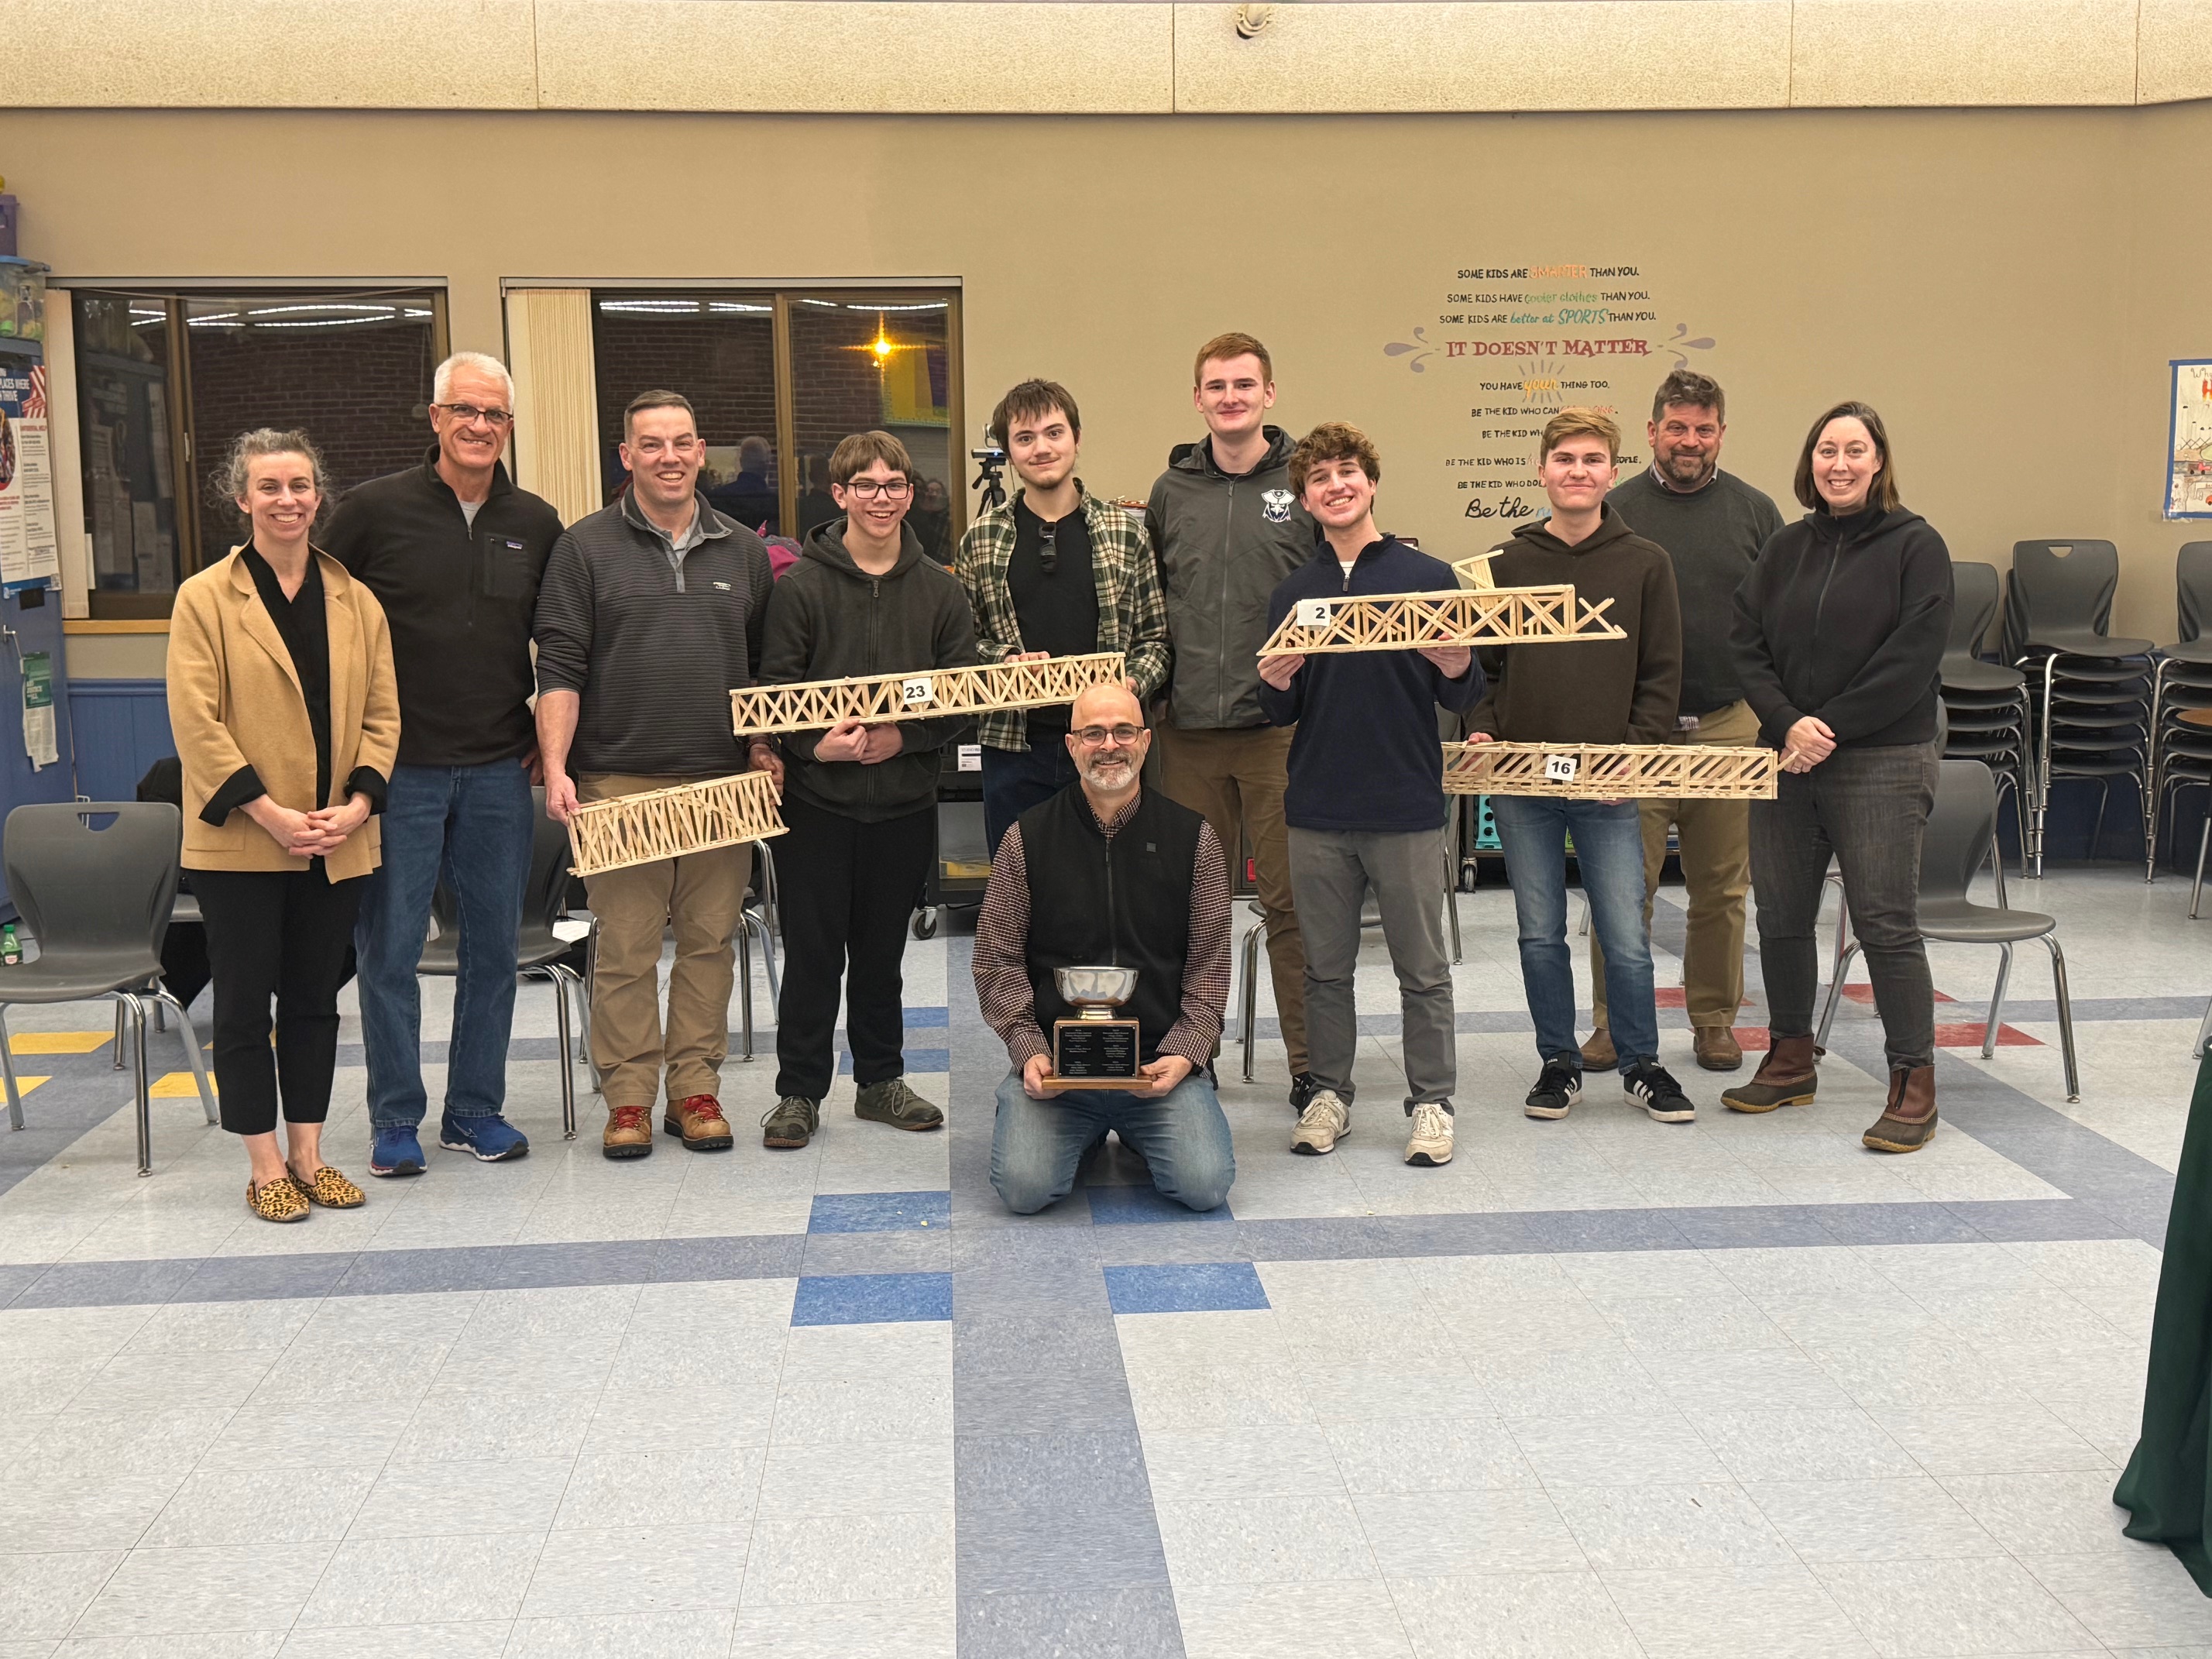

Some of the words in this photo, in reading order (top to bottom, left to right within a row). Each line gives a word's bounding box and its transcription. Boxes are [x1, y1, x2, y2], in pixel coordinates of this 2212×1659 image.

[1458, 269, 1484, 279] SOME
[1486, 269, 1509, 279] KIDS
[1510, 268, 1529, 279] ARE
[1529, 264, 1587, 279] SMARTER
[1589, 267, 1615, 277] THAN
[1617, 266, 1640, 276] YOU.
[1447, 294, 1473, 303] SOME
[1475, 294, 1497, 303] KIDS
[1499, 294, 1523, 303] HAVE
[1559, 291, 1598, 303] clothes
[1600, 291, 1626, 301] THAN
[1627, 290, 1650, 301] YOU.
[1439, 314, 1465, 324] SOME
[1468, 314, 1489, 324] KIDS
[1491, 314, 1508, 324] ARE
[1510, 311, 1540, 324] better
[1542, 313, 1554, 324] at
[1558, 308, 1609, 325] SPORTS
[1609, 312, 1633, 322] THAN
[1635, 311, 1657, 321] YOU.
[1446, 341, 1467, 357] IT
[1472, 341, 1558, 356] DOESN'T
[1562, 338, 1652, 358] MATTER
[1480, 382, 1499, 390] YOU
[1499, 382, 1523, 390] HAVE
[1523, 379, 1559, 399] your
[1590, 380, 1610, 389] TOO.
[1503, 407, 1518, 415] KID
[1482, 431, 1492, 439] BE
[1512, 429, 1527, 438] KID
[1516, 457, 1526, 465] IS
[1471, 480, 1487, 489] THE
[1465, 498, 1498, 518] Be
[1499, 496, 1534, 518] the
[1315, 606, 1325, 619] 2
[905, 685, 926, 699] 23
[1551, 761, 1571, 774] 16
